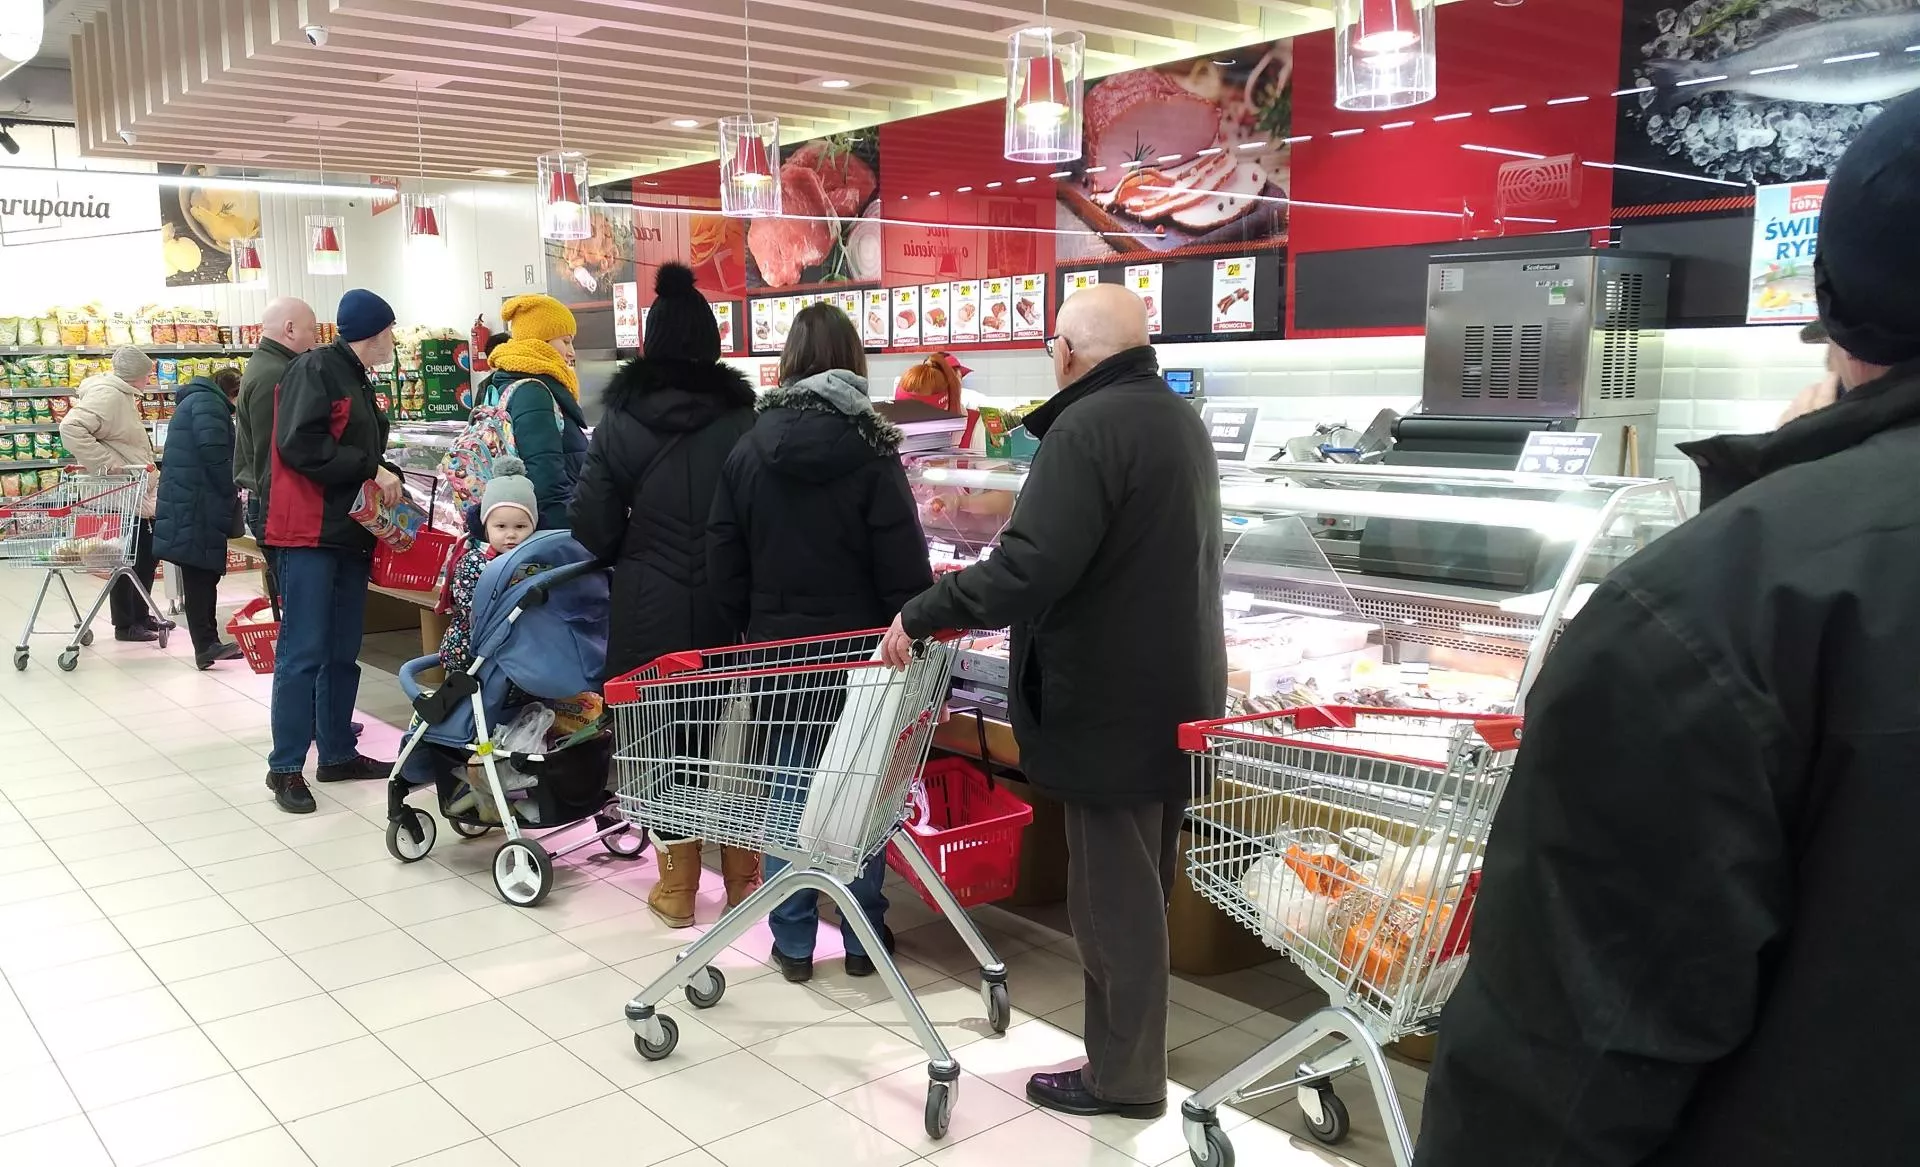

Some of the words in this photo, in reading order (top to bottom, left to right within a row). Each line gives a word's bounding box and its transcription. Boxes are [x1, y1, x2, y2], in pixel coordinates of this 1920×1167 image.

[1791, 199, 1821, 211] TOPA
[425, 364, 456, 373] CHRUPKI
[428, 403, 458, 412] CHRUPKI
